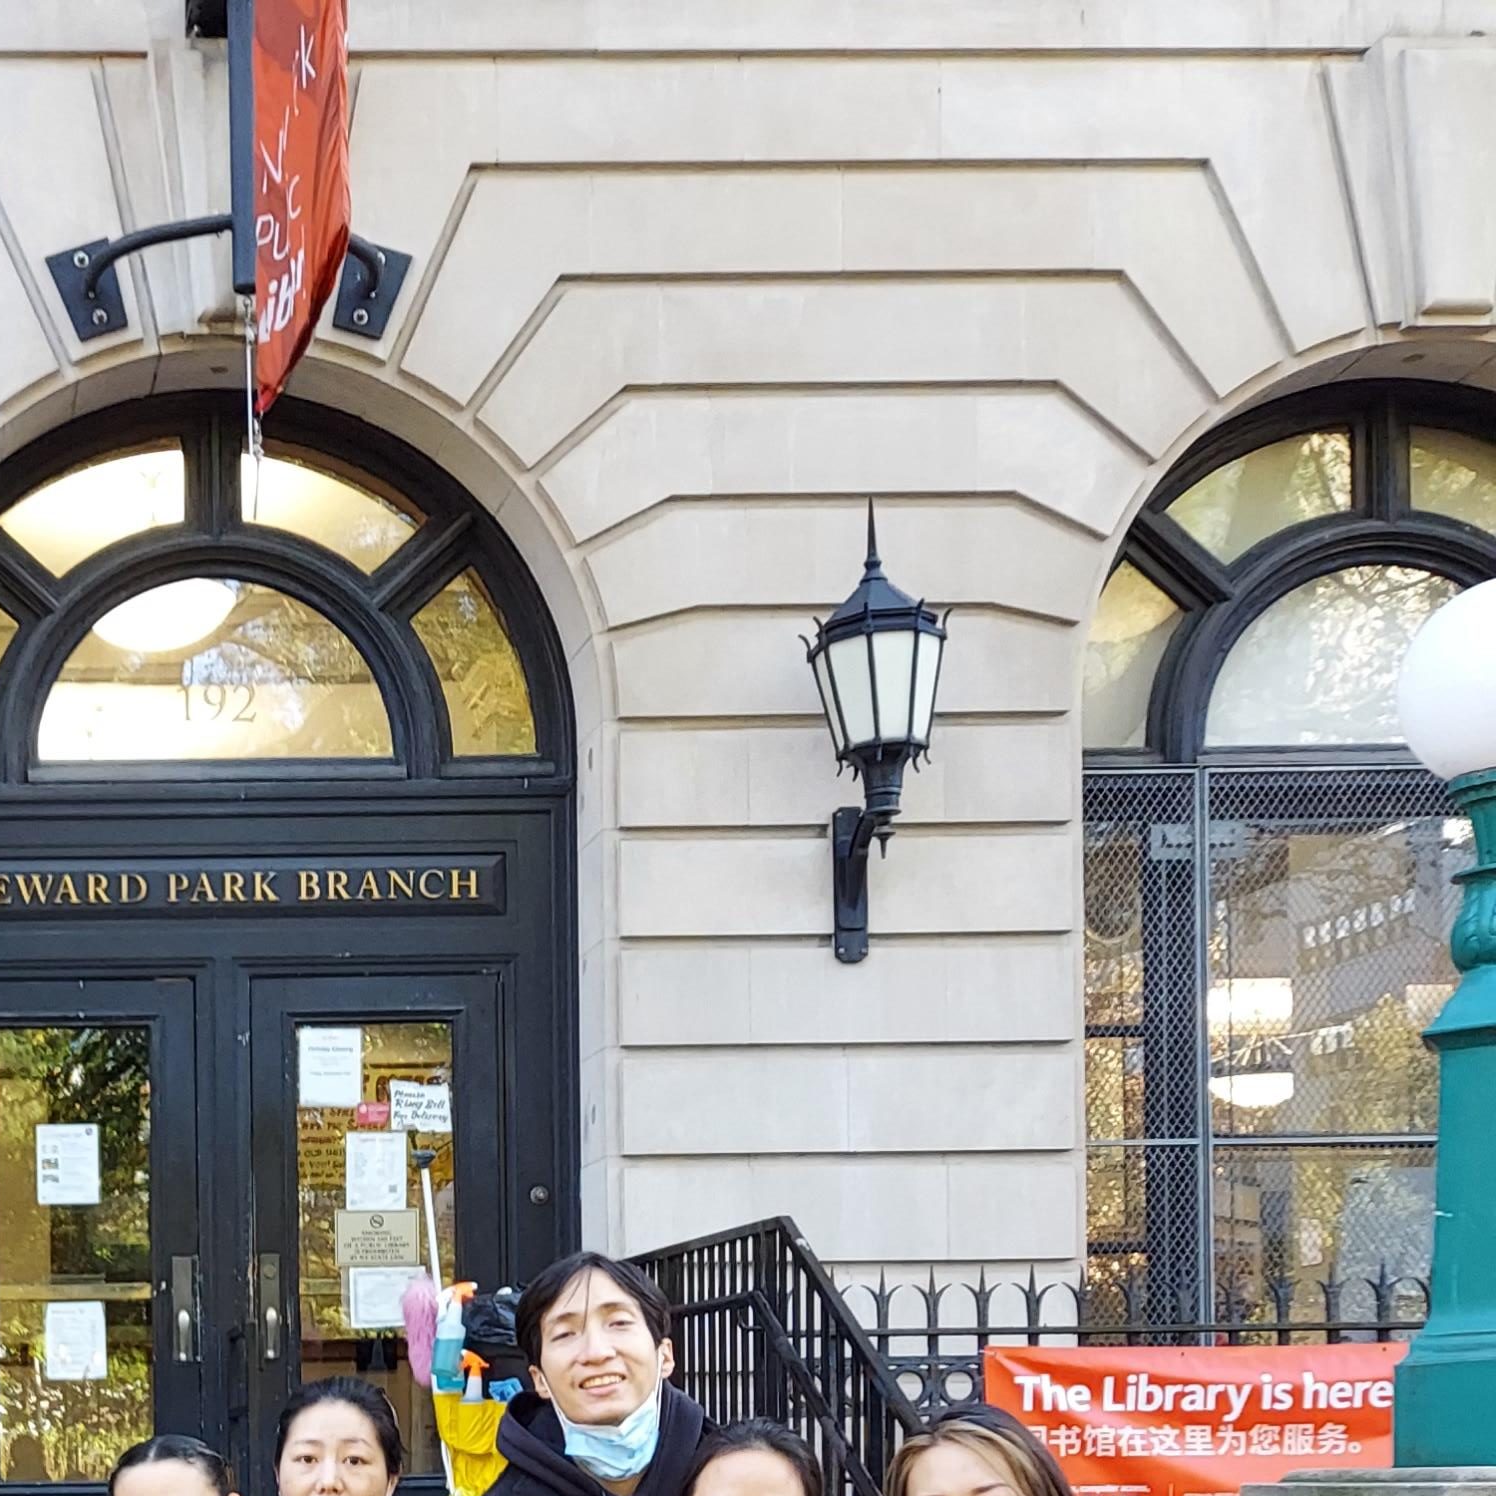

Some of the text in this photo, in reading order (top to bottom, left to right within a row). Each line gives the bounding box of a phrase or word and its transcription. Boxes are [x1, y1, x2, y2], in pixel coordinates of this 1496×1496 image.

[177, 684, 258, 723] 192
[167, 869, 279, 903] PARK
[297, 868, 480, 900] BRANCH
[1014, 1372, 1394, 1421] The Library is here
